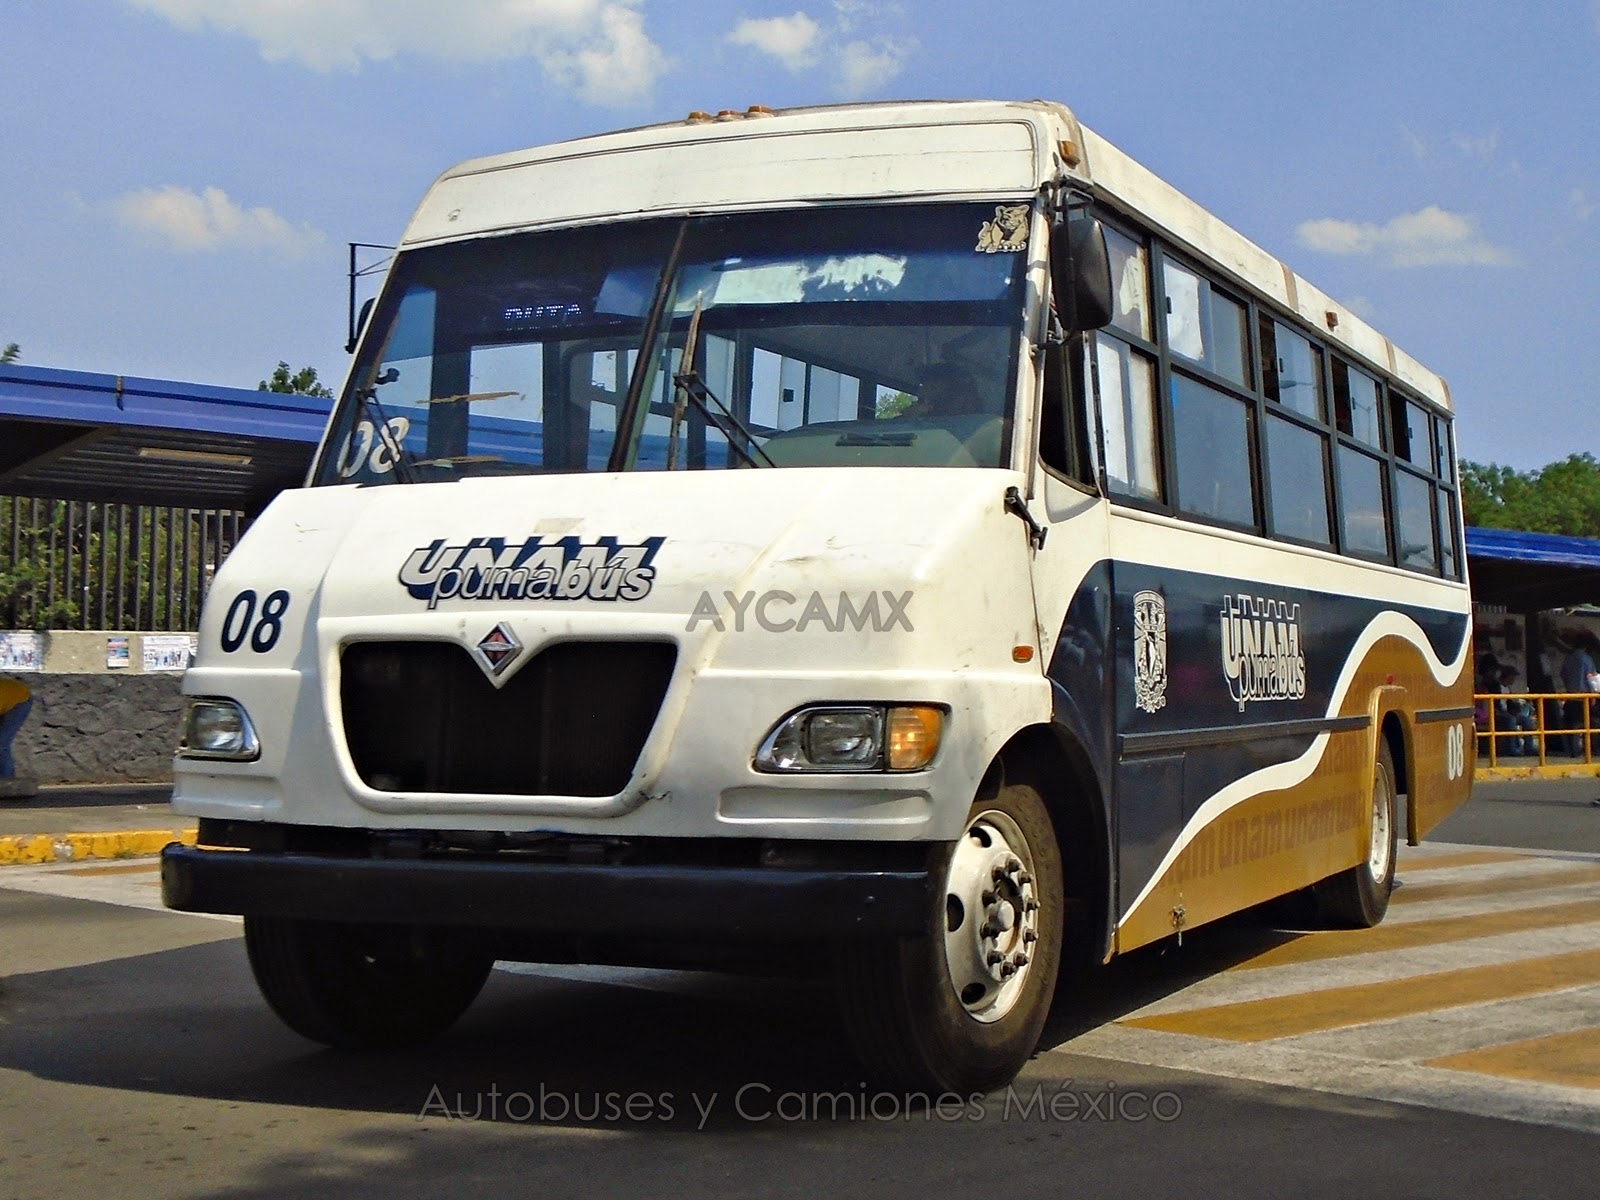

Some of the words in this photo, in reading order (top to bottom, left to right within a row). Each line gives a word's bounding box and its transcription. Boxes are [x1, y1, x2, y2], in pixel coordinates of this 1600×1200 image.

[336, 416, 411, 479] 08
[399, 536, 667, 592] UNAM
[221, 589, 291, 654] 08
[1220, 594, 1301, 680] UNAM
[1448, 722, 1464, 781] 08
